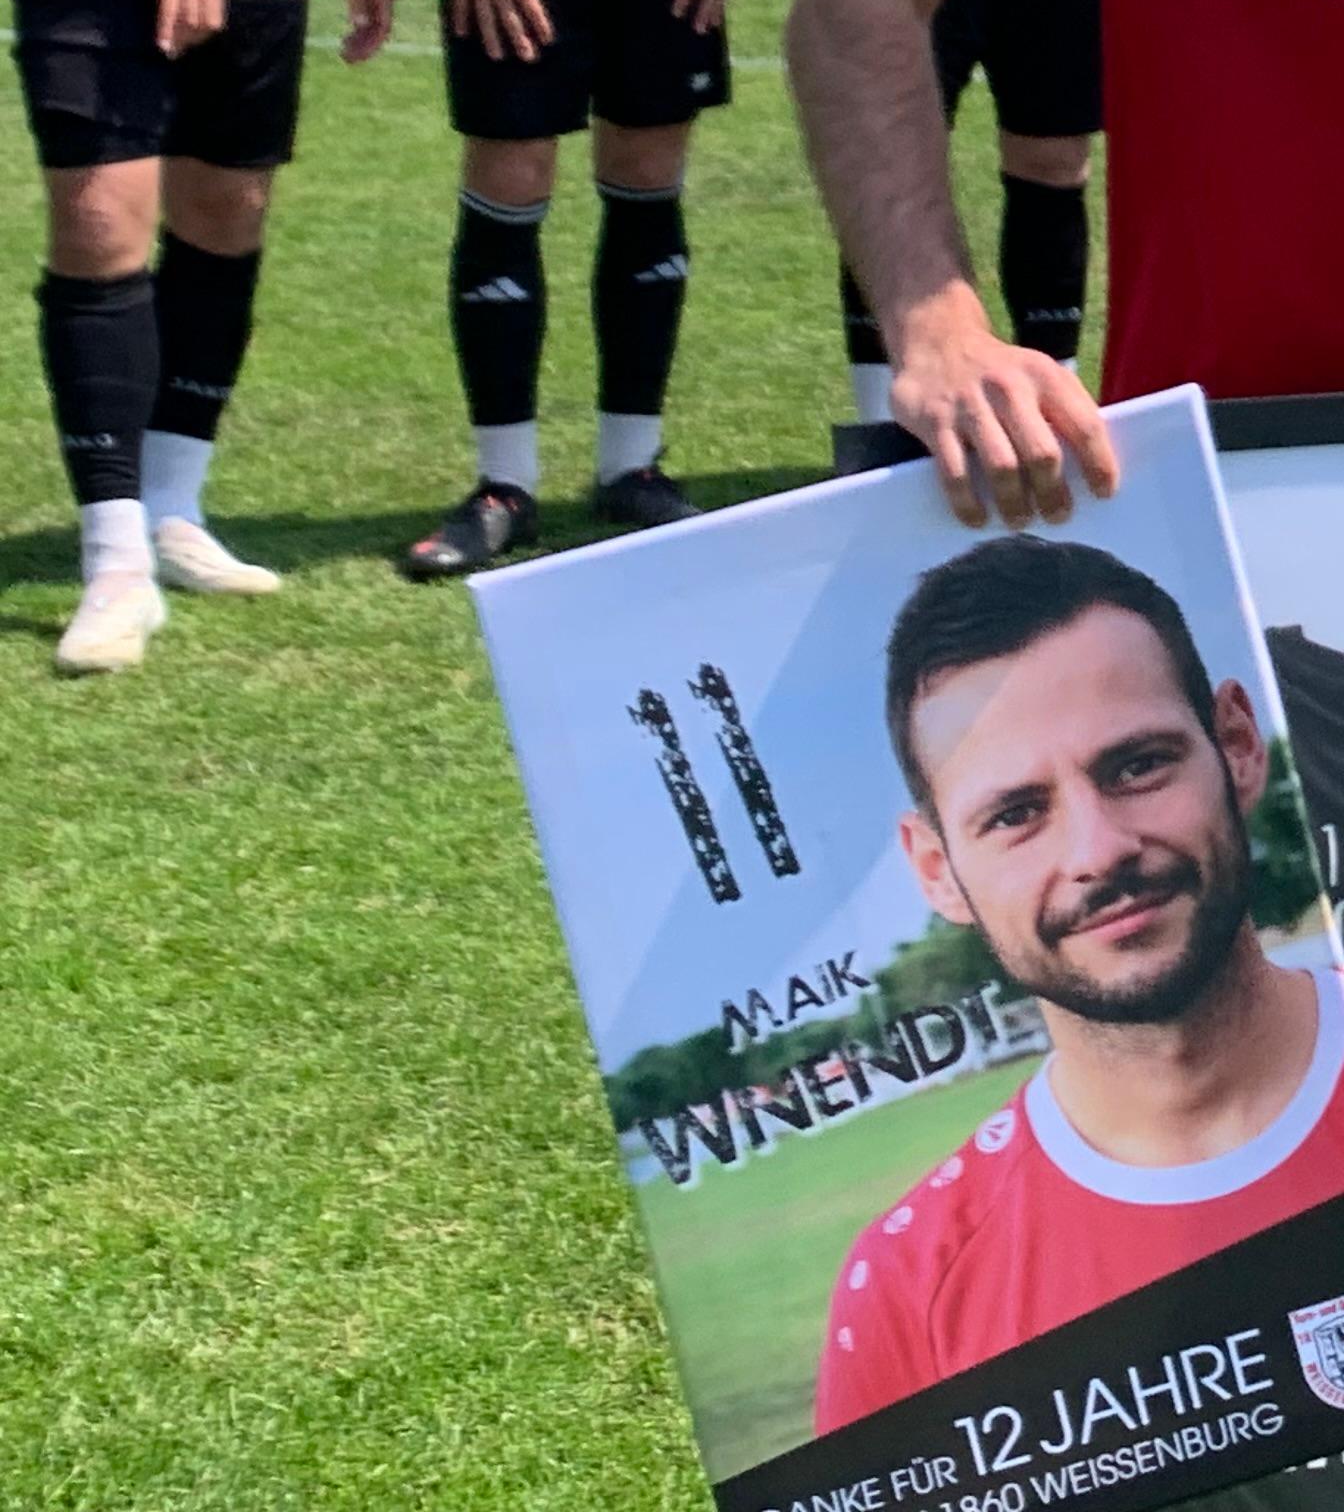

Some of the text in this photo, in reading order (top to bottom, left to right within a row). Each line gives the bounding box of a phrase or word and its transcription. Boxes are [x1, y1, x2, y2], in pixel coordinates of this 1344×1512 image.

[625, 662, 801, 906] 11
[639, 980, 1001, 1185] WNENDT
[722, 951, 872, 1051] MAIK
[761, 1329, 1274, 1512] NKE FÜR 12 JAHRE
[1029, 1403, 1286, 1502] WEISSENBURG
